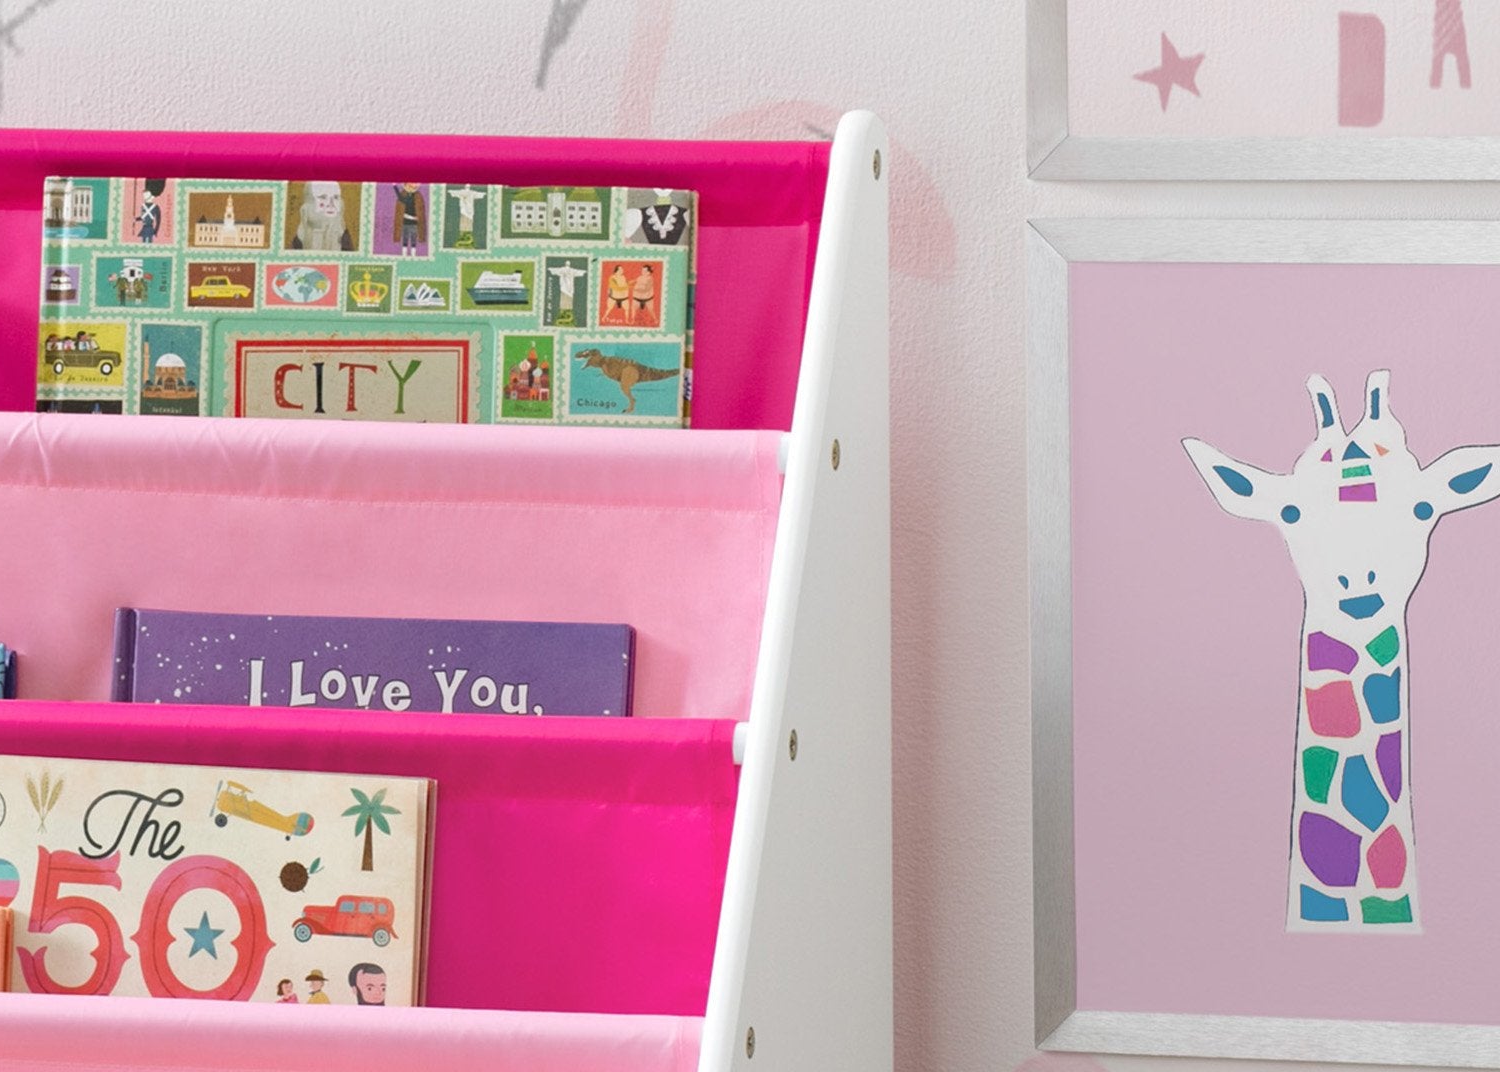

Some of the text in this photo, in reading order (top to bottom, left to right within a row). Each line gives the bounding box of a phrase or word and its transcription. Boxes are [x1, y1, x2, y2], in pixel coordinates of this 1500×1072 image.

[159, 261, 167, 292] Berlin
[274, 359, 422, 414] CITY
[576, 398, 617, 409] Chicago
[248, 658, 544, 717] I Love You,
[78, 788, 185, 861] The
[16, 844, 277, 1002] 50
